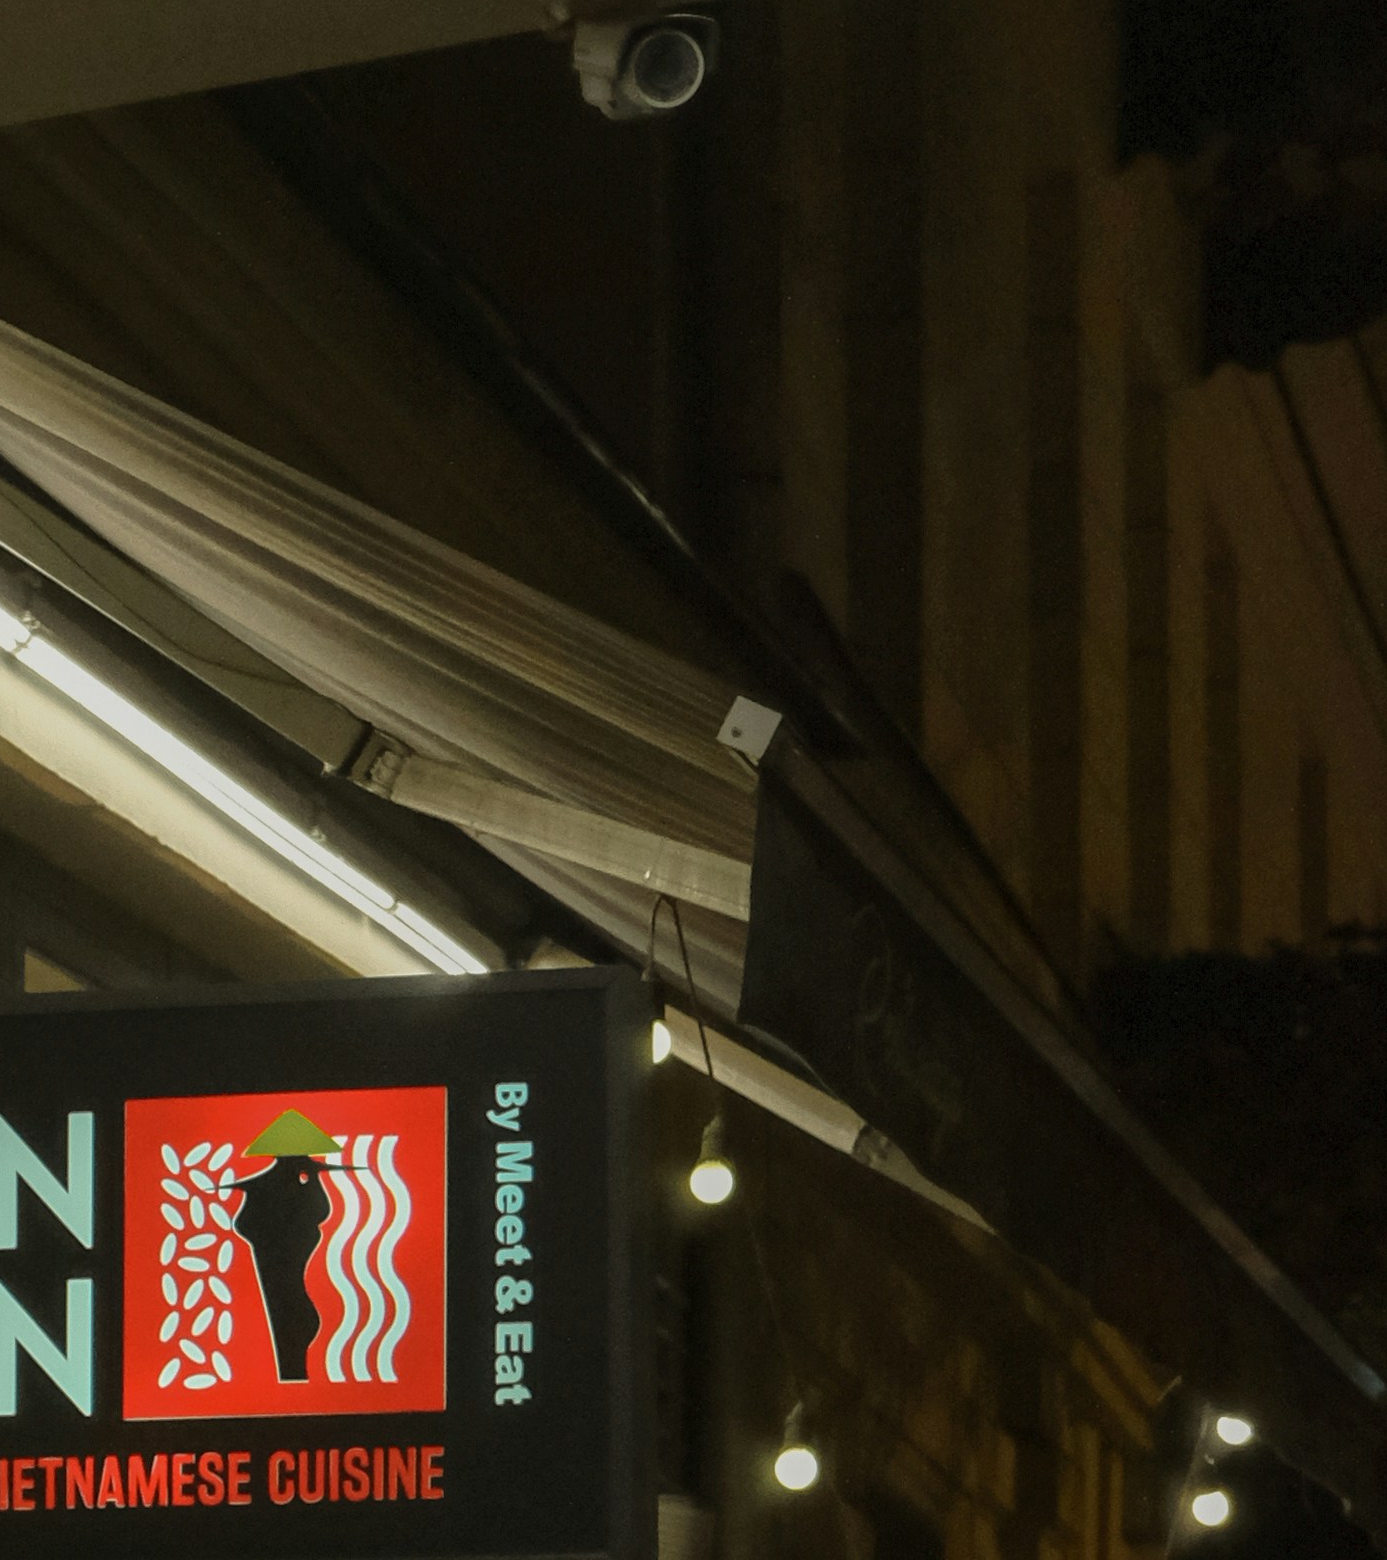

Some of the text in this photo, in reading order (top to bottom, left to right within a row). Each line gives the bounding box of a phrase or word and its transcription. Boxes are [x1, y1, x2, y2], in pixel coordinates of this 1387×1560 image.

[482, 1080, 535, 1407] By Meet & Eat
[266, 1443, 447, 1506] CUISINE
